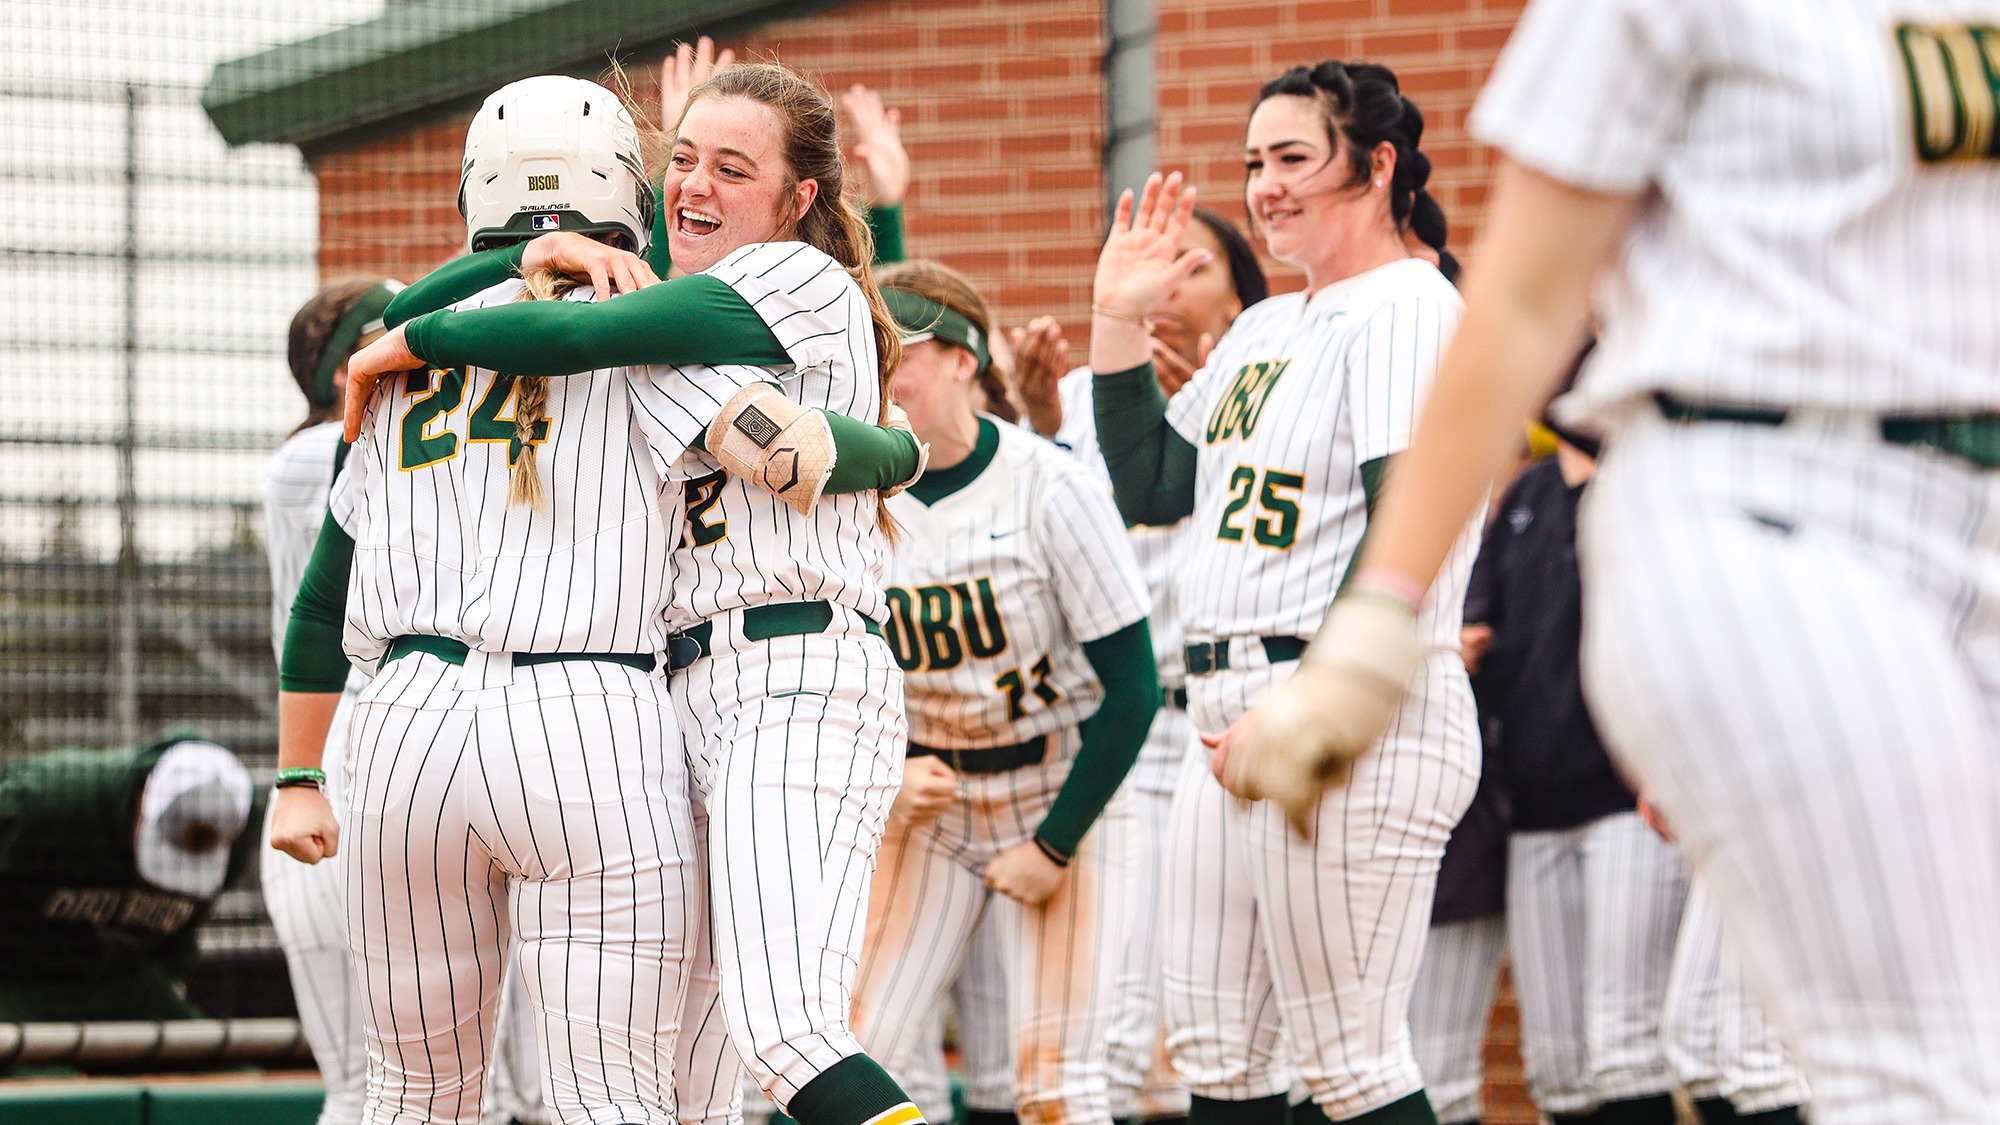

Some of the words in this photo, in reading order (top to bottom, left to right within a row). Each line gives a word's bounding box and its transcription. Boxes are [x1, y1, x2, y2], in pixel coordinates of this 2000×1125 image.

[519, 203, 571, 212] RAWLINGS
[527, 174, 560, 192] BISON
[398, 364, 553, 473] 24
[1206, 357, 1292, 446] OBU
[676, 466, 729, 550] 2
[1217, 464, 1306, 552] 25
[884, 576, 1009, 673] OBU
